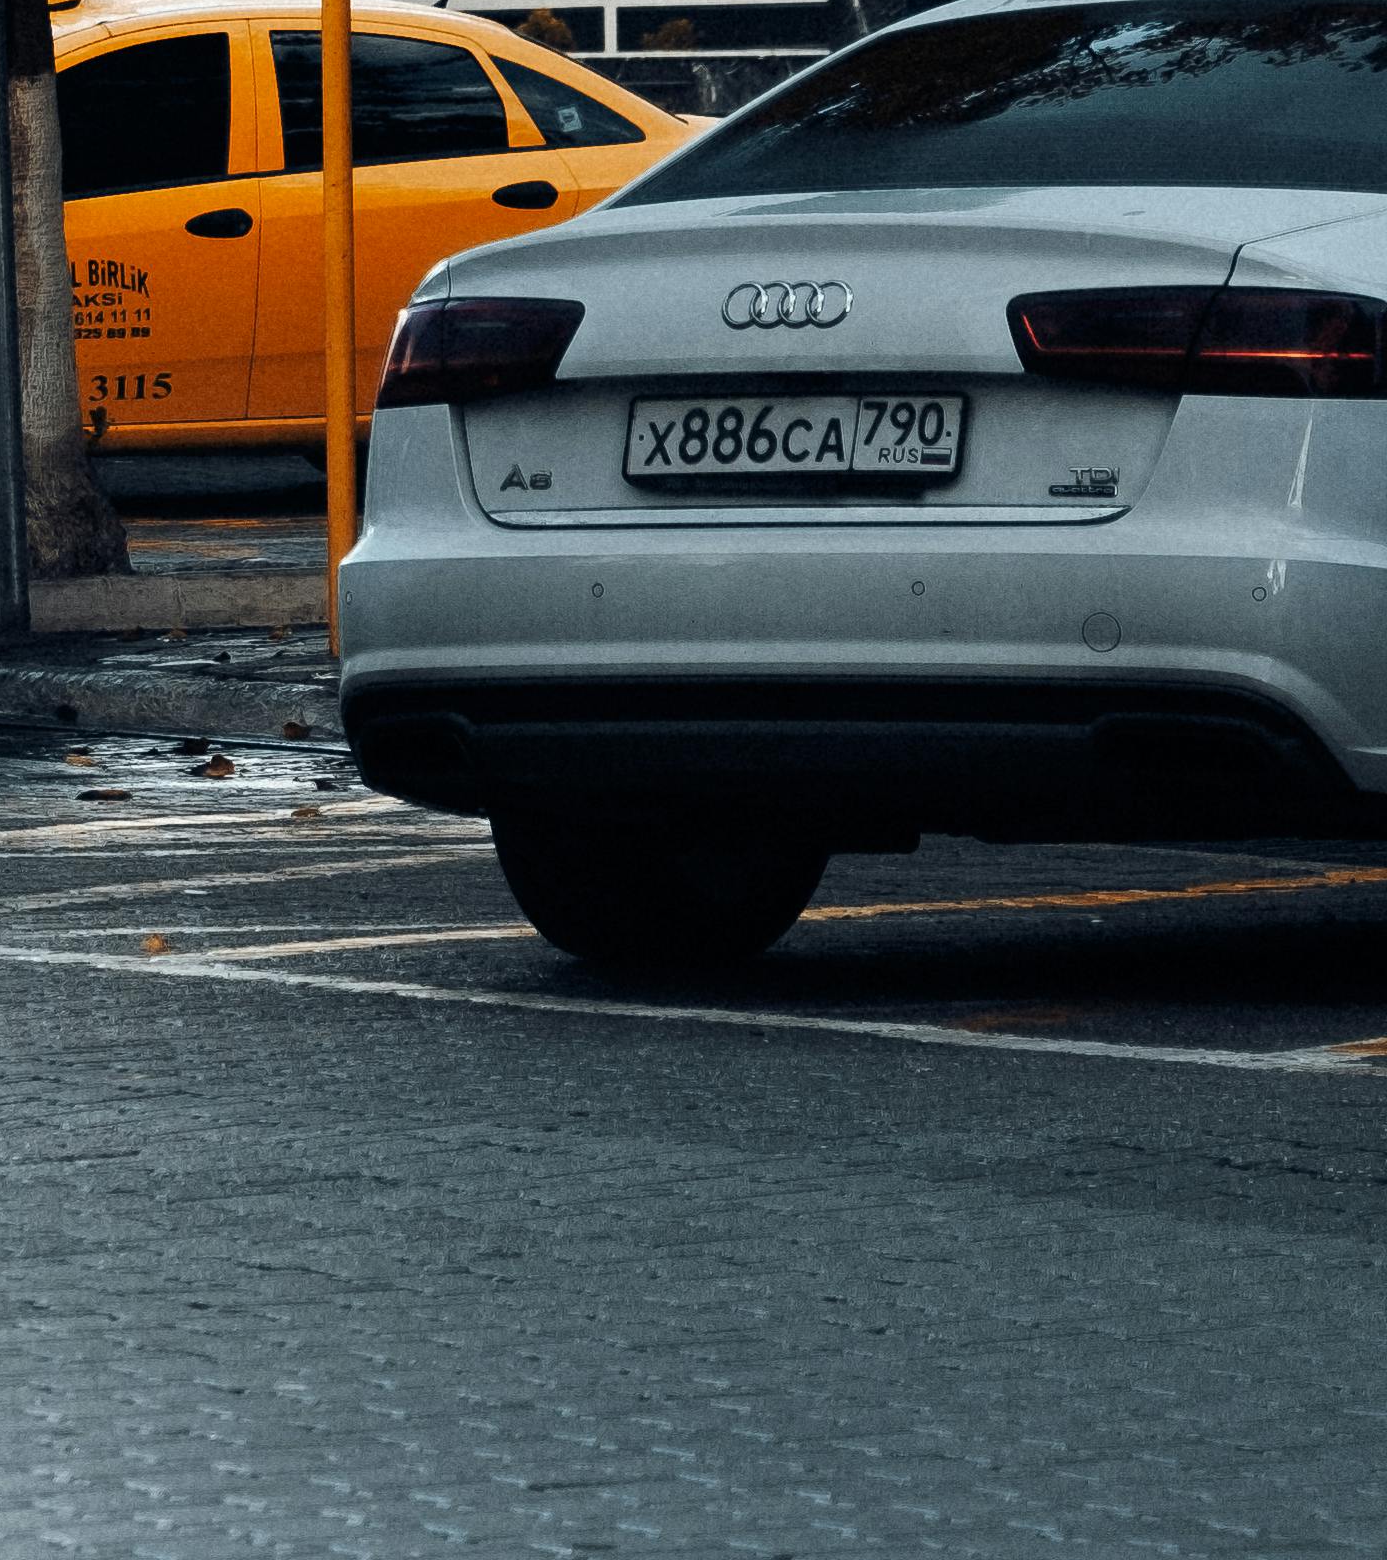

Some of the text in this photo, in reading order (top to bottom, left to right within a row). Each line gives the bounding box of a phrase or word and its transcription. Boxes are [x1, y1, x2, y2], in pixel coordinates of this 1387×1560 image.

[75, 308, 150, 325] 614 11 11
[89, 372, 172, 401] 3115
[862, 401, 945, 446] 790
[878, 447, 919, 464] RUS
[500, 464, 552, 491] A6
[1069, 467, 1120, 484] TDI
